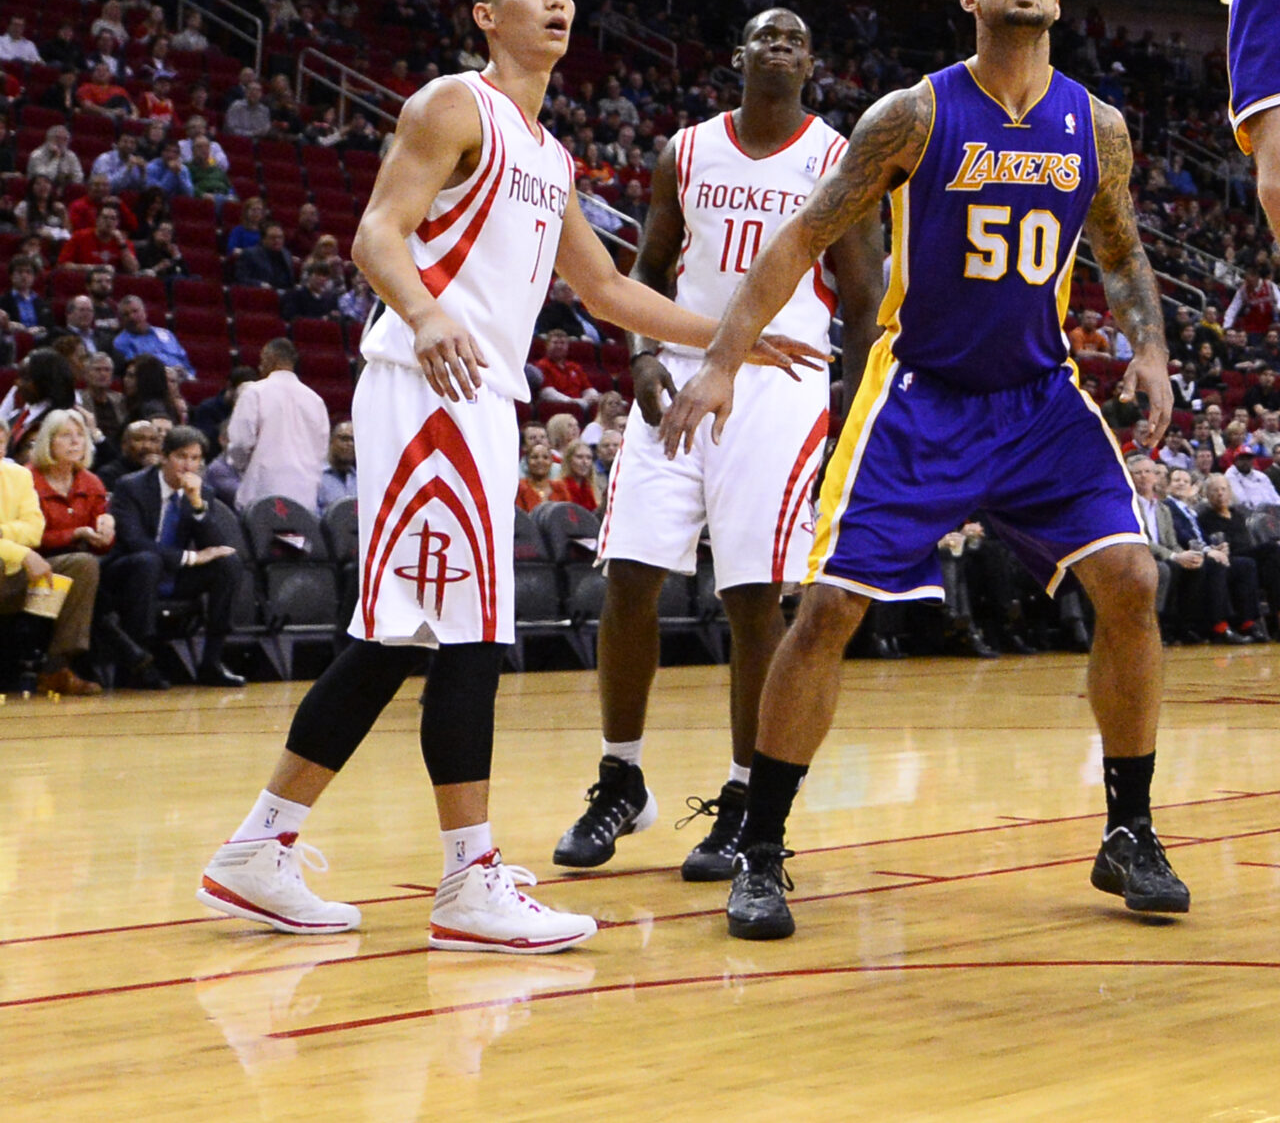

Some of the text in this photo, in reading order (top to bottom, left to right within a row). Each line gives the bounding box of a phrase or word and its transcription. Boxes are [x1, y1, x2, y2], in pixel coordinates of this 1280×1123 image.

[945, 141, 1081, 193] LAKERS
[696, 180, 806, 215] ROCKETS
[530, 218, 547, 283] 7
[719, 218, 763, 274] 10
[963, 204, 1061, 286] 50
